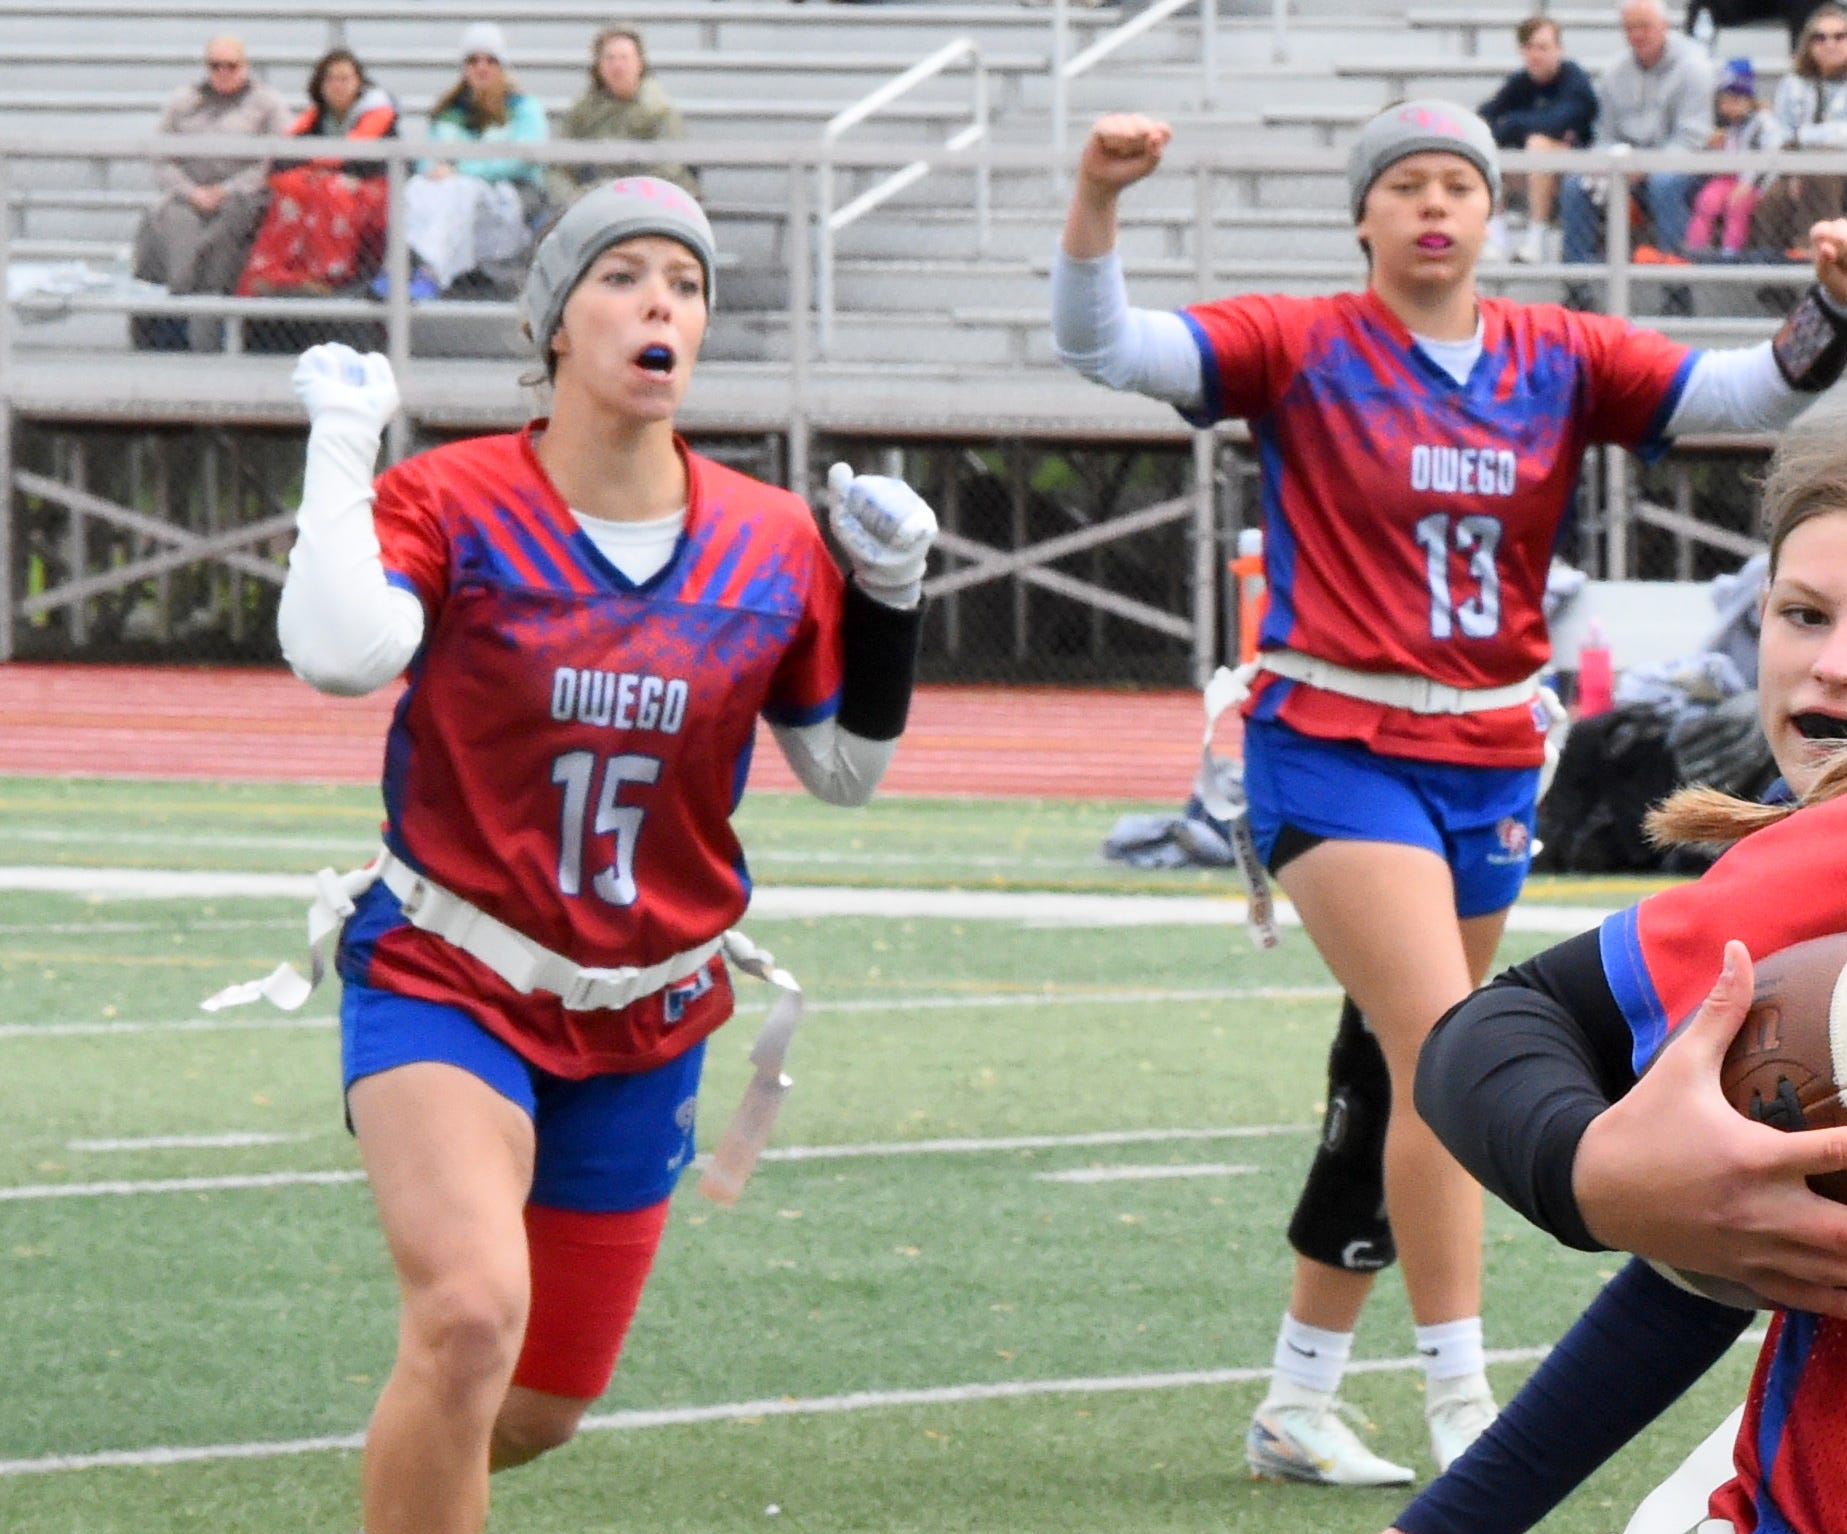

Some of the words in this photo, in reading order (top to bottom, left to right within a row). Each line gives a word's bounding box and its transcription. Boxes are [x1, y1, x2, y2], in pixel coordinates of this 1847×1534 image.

[1411, 444, 1517, 496] OWEGO
[1415, 512, 1502, 639] 13
[552, 666, 688, 735] OWEGO
[552, 751, 661, 906] 15
